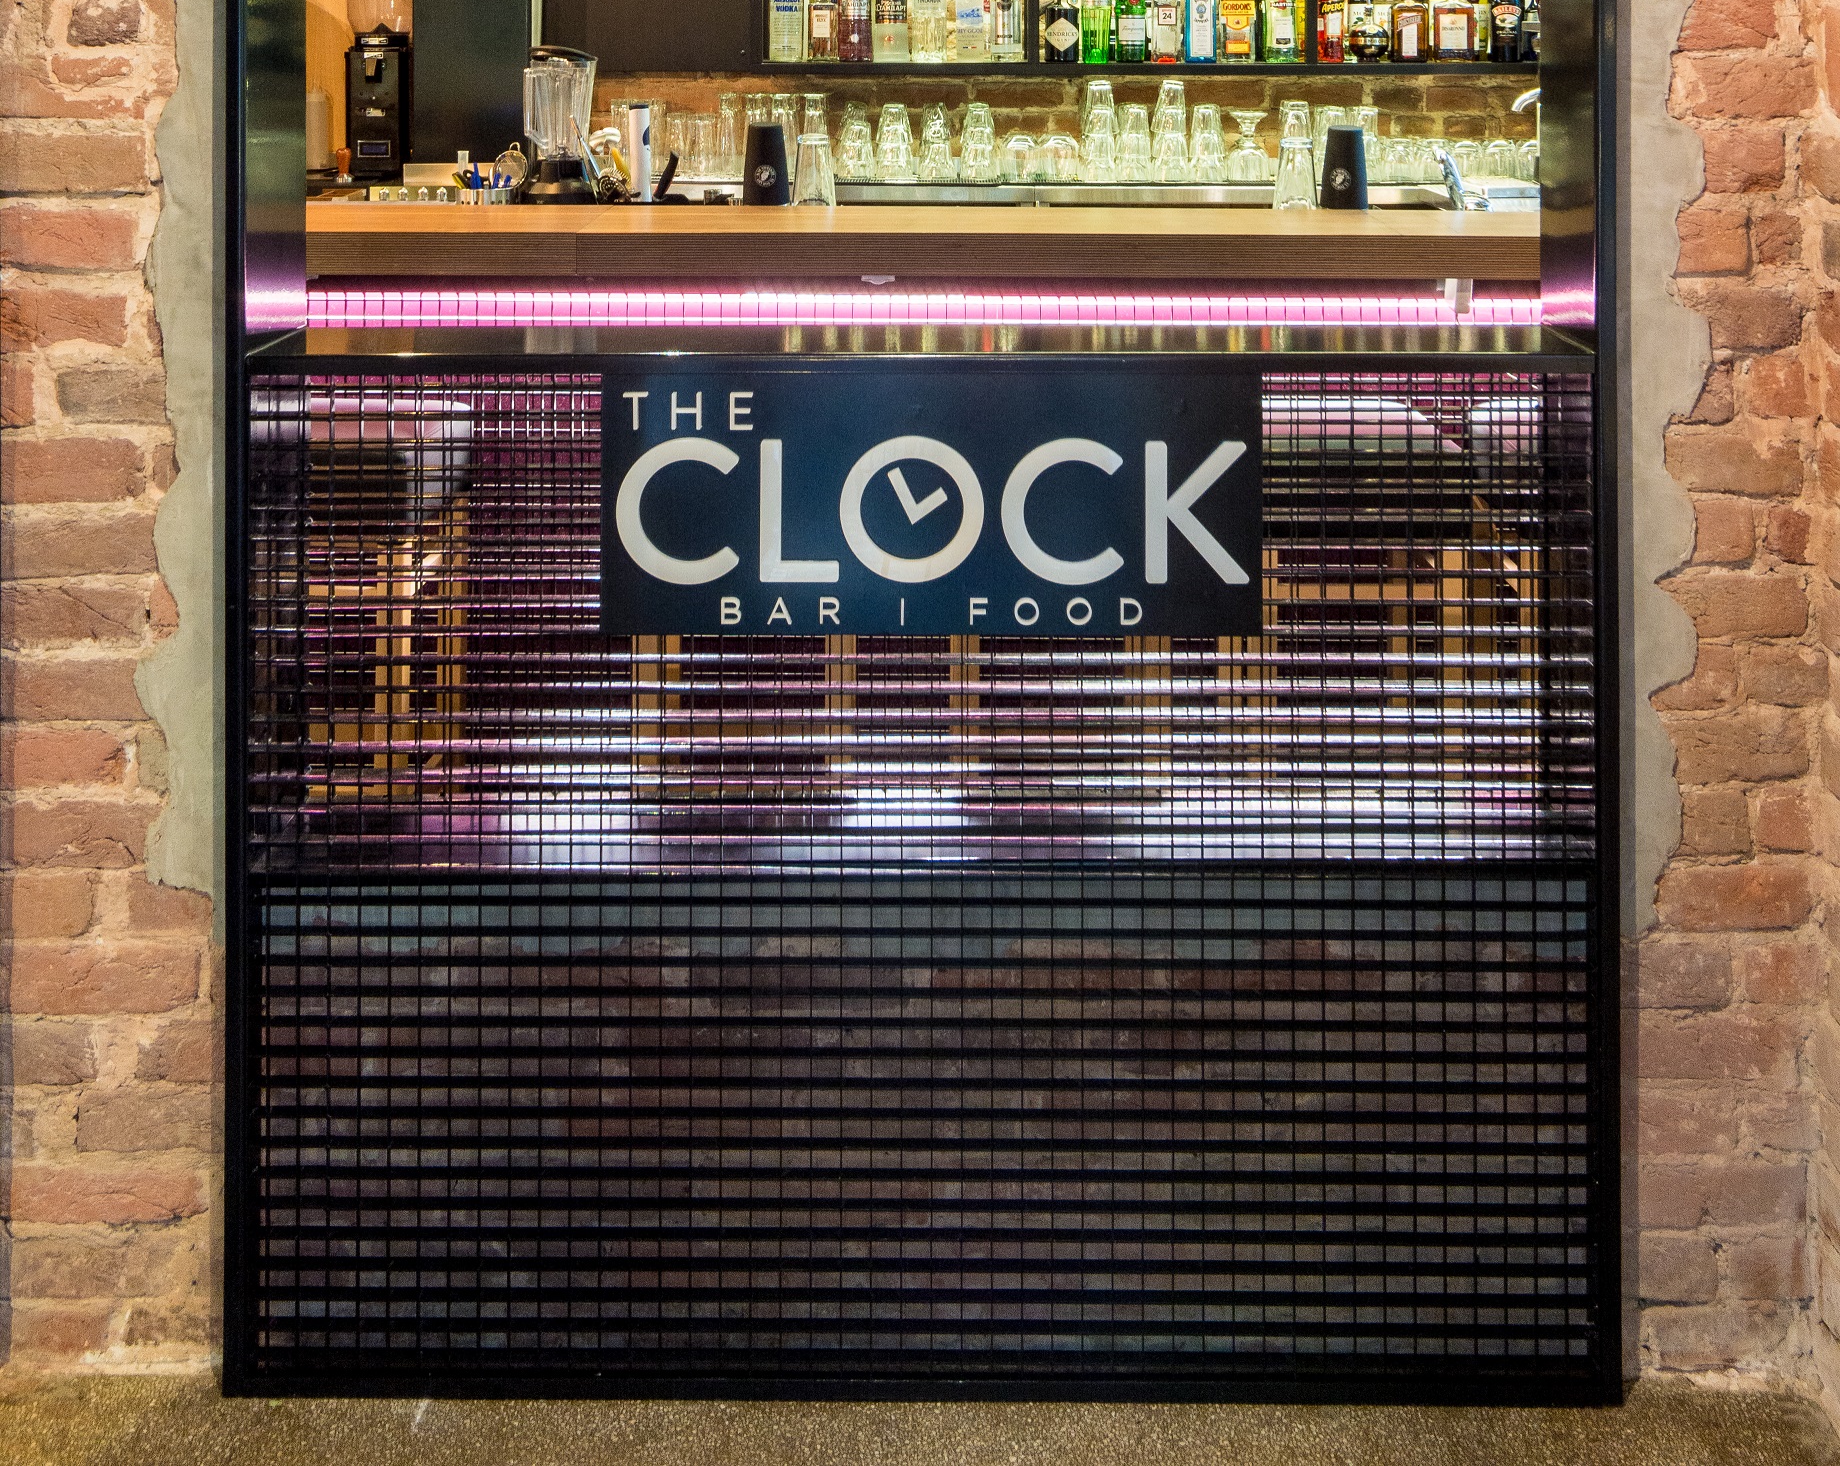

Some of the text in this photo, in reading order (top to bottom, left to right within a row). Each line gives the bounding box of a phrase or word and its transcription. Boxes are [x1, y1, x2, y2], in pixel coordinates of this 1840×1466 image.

[1162, 12, 1172, 20] 24
[621, 390, 755, 431] THE
[615, 435, 1250, 585] CLOCK
[720, 596, 841, 626] BAR
[968, 596, 1143, 626] FOOD
